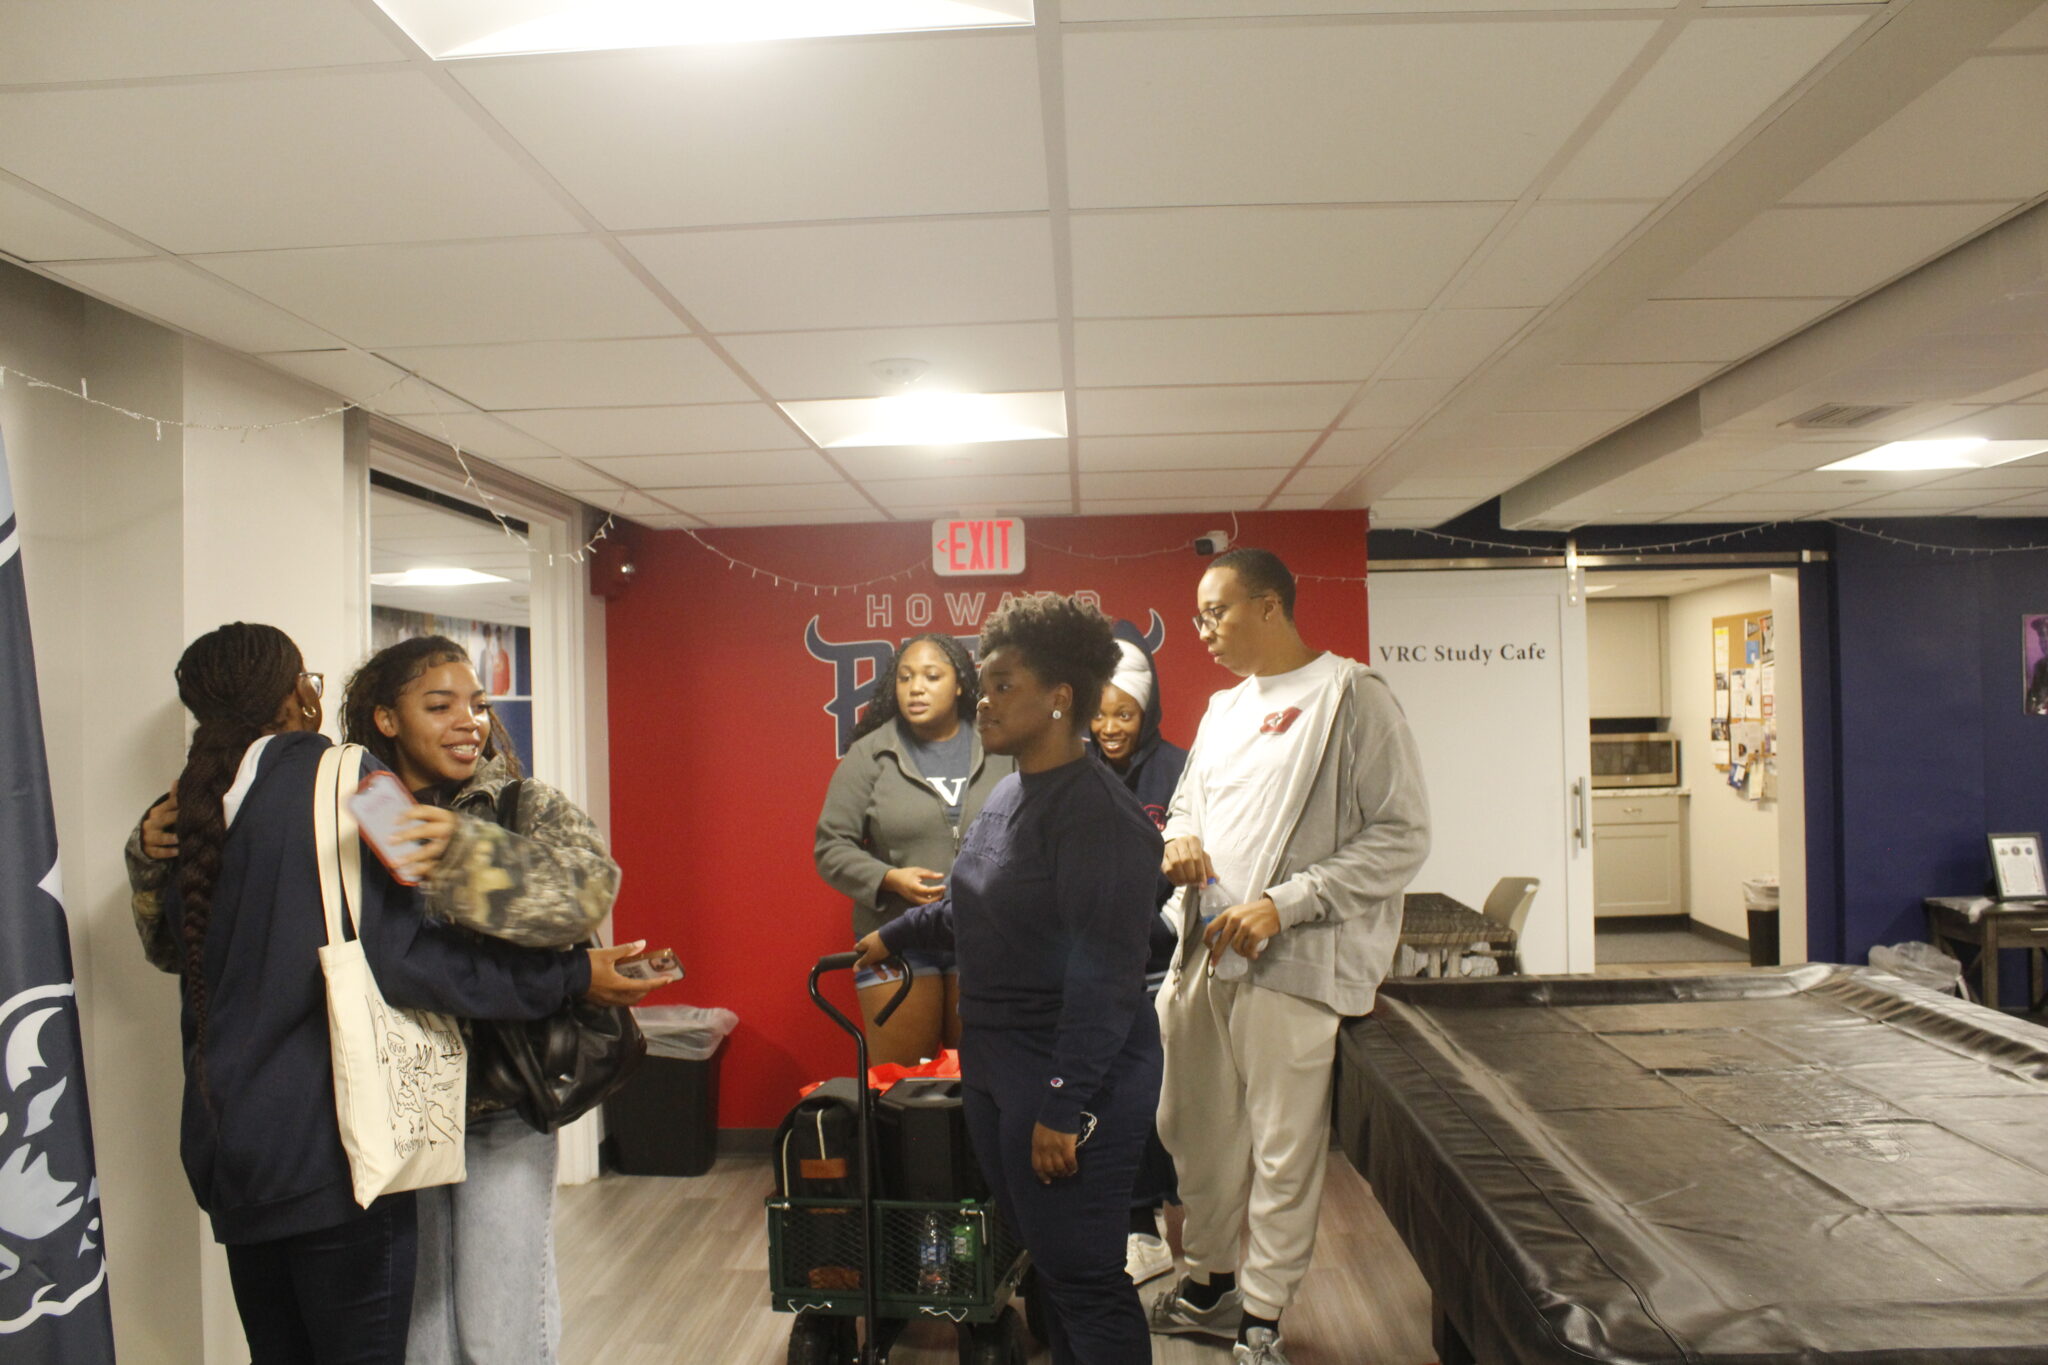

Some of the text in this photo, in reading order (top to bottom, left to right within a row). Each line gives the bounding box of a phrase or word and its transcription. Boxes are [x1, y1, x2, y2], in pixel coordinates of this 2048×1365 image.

[949, 520, 1014, 570] EXIT
[1379, 643, 1546, 666] VRC Study Cafe
[926, 776, 967, 807] V
